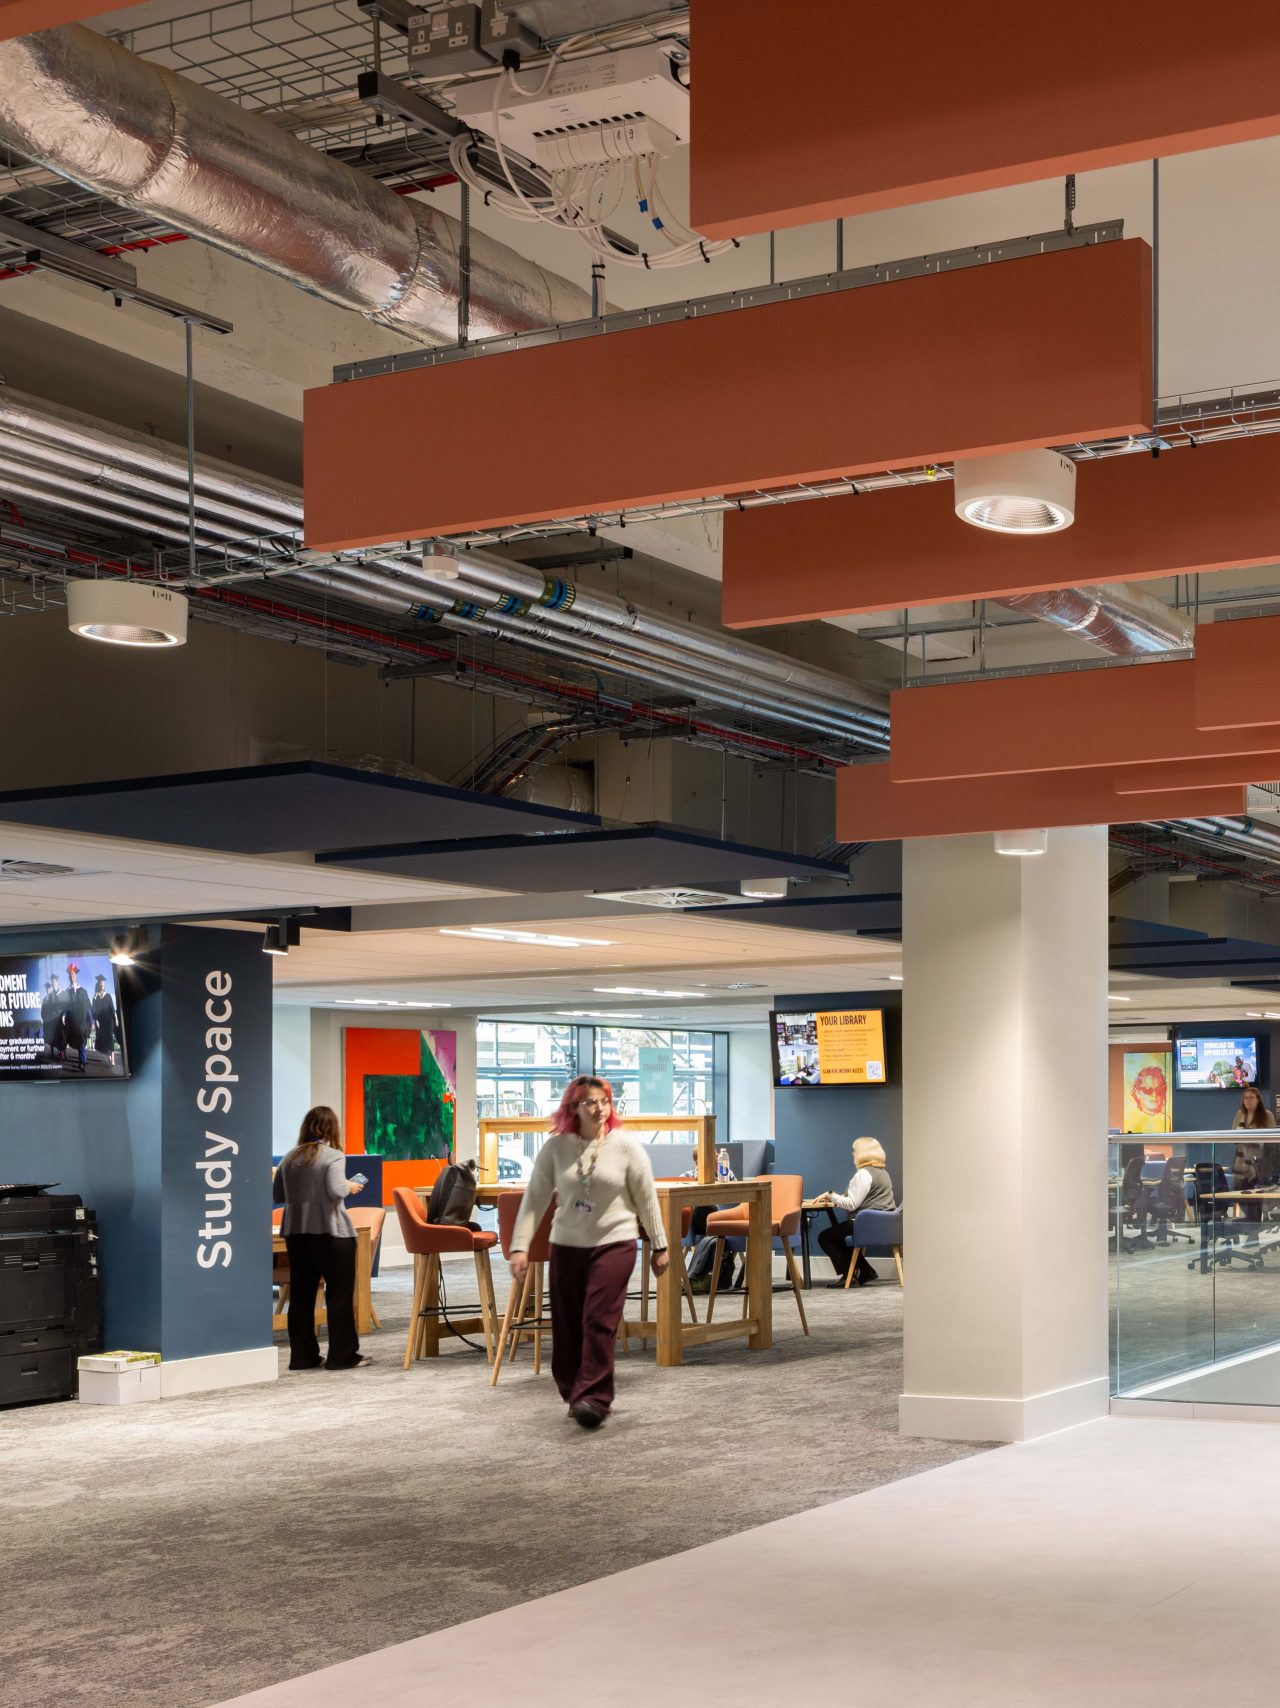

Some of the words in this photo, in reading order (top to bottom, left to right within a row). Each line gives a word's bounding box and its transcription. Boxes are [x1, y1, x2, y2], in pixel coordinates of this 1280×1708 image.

[0, 974, 27, 991] OMENT
[8, 991, 41, 1009] FUTURE
[0, 1011, 14, 1027] INS
[820, 1016, 838, 1026] YOUR
[840, 1014, 867, 1025] LIBRARY
[9, 1037, 35, 1045] graduates
[196, 970, 239, 1114] Space
[195, 1130, 239, 1269] Study
